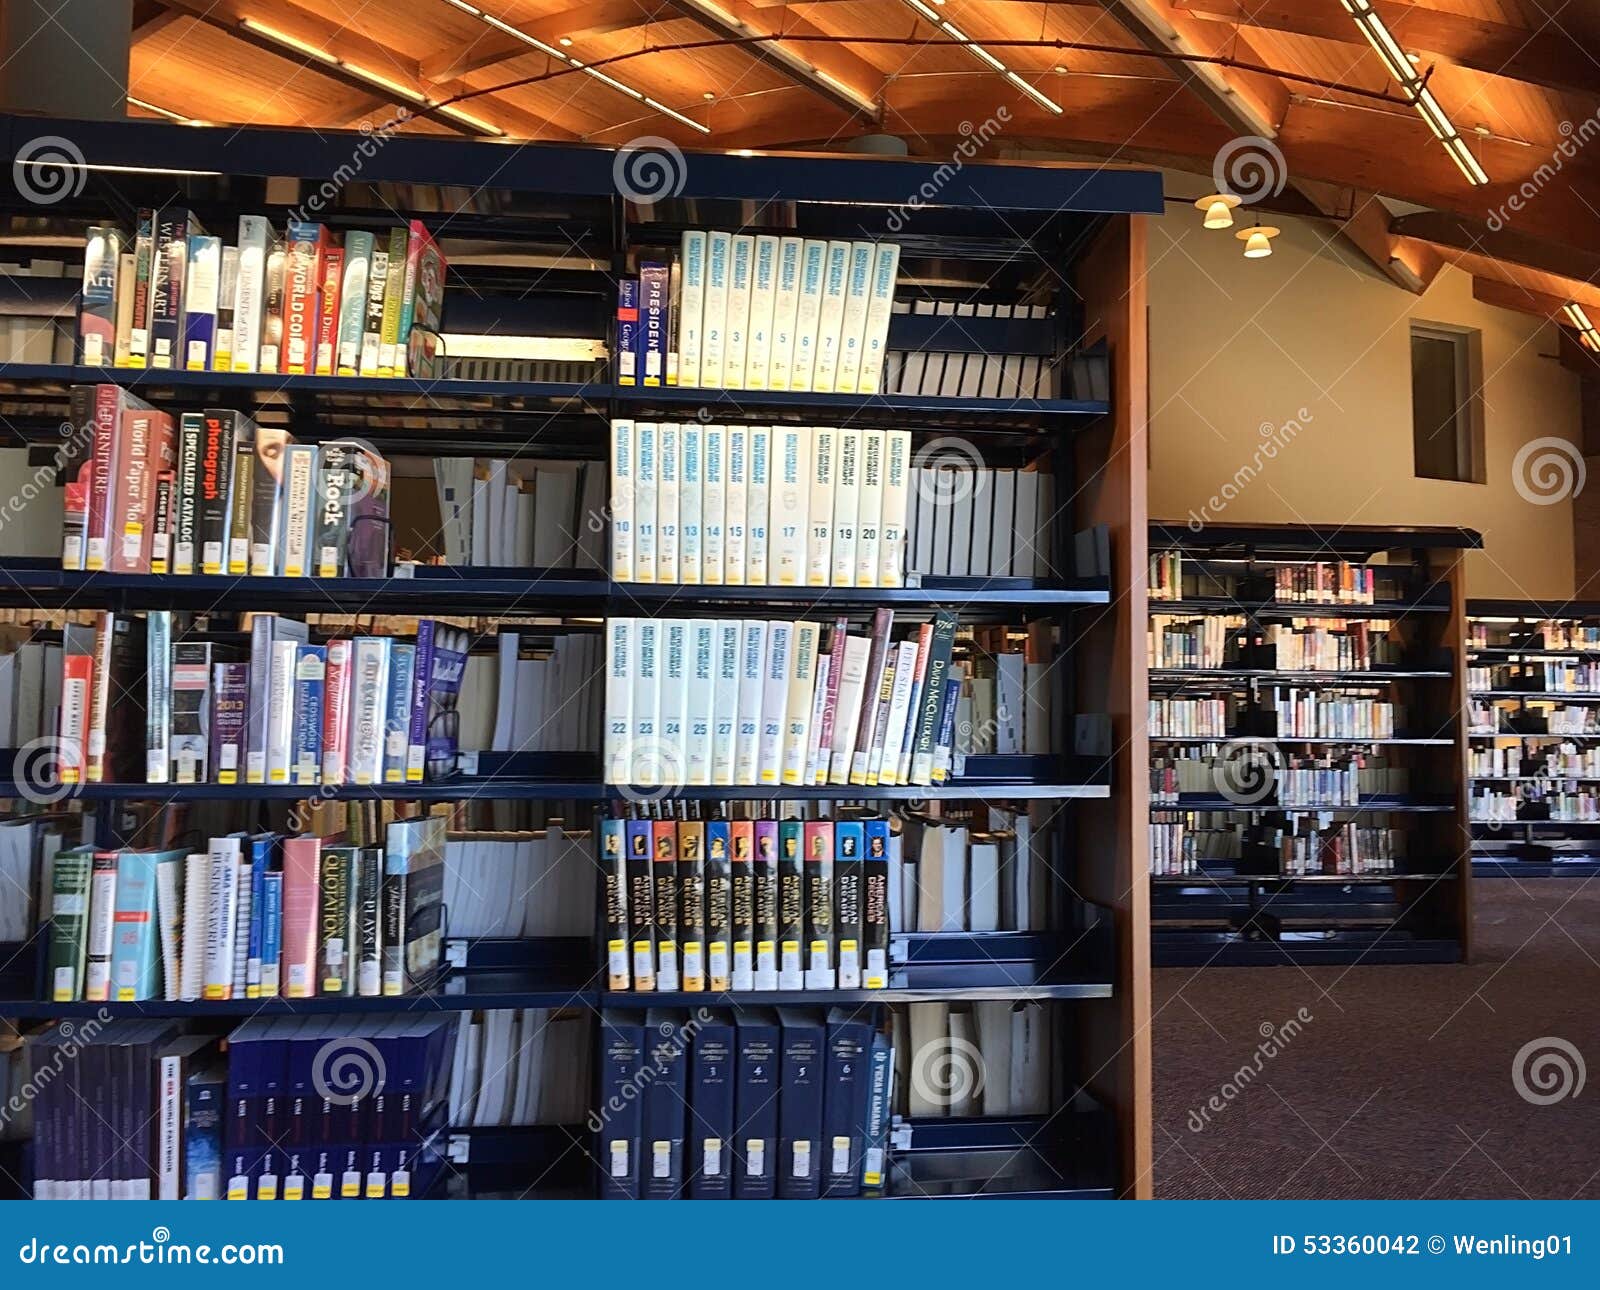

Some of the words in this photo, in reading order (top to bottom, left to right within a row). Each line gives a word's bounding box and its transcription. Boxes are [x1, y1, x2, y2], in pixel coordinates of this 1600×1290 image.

[88, 273, 114, 288] Art
[154, 288, 167, 316] ART
[132, 419, 148, 457] World
[183, 433, 197, 495] SPECIALIZED
[202, 419, 222, 500] photograph
[125, 459, 145, 498] Paper
[324, 473, 346, 526] Rock
[616, 521, 629, 532] 10
[640, 525, 652, 535] 11
[662, 526, 675, 536] 12
[684, 526, 697, 536] 13
[707, 526, 720, 536] 14
[730, 527, 742, 537] 15
[752, 528, 765, 538] 16
[783, 527, 796, 537] 17
[814, 528, 827, 538] 18
[839, 529, 852, 539] 19
[863, 529, 876, 539] 20
[886, 530, 898, 540] 21
[930, 660, 945, 687] DAVID
[217, 701, 243, 710] 2013
[612, 723, 626, 734] 22
[640, 723, 653, 734] 23
[666, 724, 680, 734] 24
[694, 724, 707, 735] 25
[719, 724, 732, 734] 27
[742, 724, 755, 734] 28
[766, 724, 779, 735] 29
[790, 724, 803, 735] 30
[850, 875, 858, 925] AMERICAN
